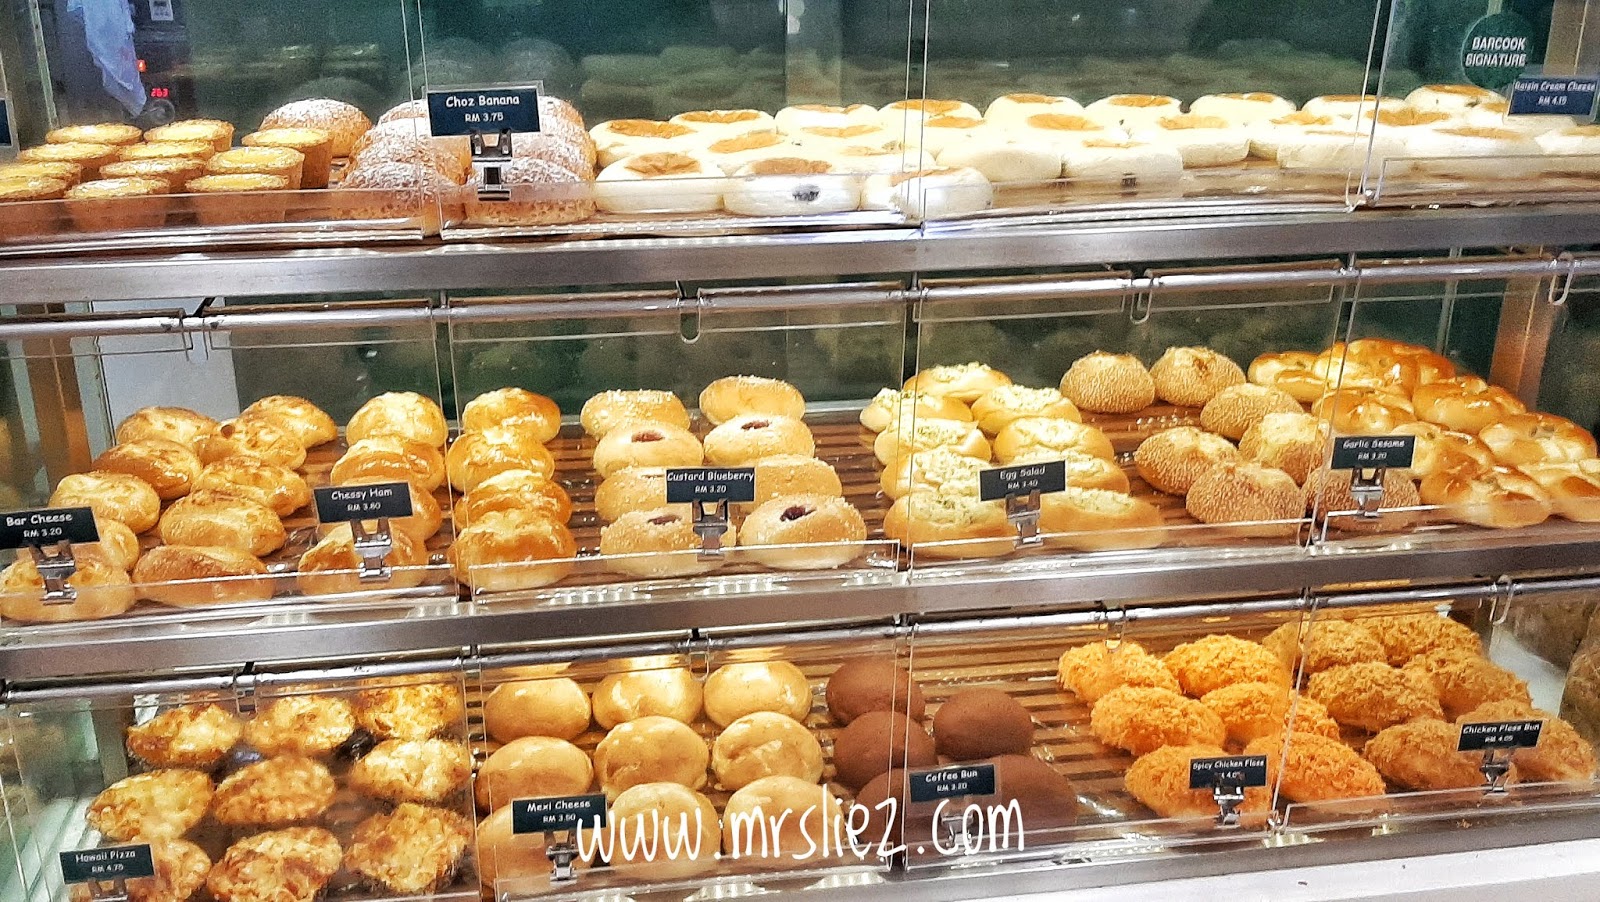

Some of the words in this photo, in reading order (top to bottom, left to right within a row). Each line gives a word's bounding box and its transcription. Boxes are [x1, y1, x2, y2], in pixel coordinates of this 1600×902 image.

[1465, 53, 1528, 68] SIGNATURE
[1540, 81, 1566, 94] Cream
[1567, 81, 1596, 95] Cheese
[445, 95, 475, 107] Choz
[478, 94, 520, 106] Banana
[1537, 96, 1551, 106] RM
[464, 112, 481, 122] RM
[482, 111, 504, 121] 3.75
[1342, 440, 1369, 449] Garlic
[1371, 439, 1405, 449] Sesame
[1357, 452, 1370, 460] RM
[667, 471, 705, 482] Custard
[707, 470, 755, 483] Blueberry
[999, 470, 1017, 482] Egg
[1019, 465, 1046, 479] Salad
[369, 487, 393, 498] Ham
[695, 486, 708, 494] RM
[709, 485, 727, 494] 3.20
[1007, 482, 1020, 490] RM
[347, 503, 361, 512] RM
[6, 516, 27, 527] Bar
[30, 512, 73, 524] Cheese
[23, 527, 41, 539] RM
[41, 525, 63, 537] 3.20
[1462, 725, 1497, 735] Chicken
[1524, 722, 1541, 733] Bun
[1192, 761, 1212, 771] Spicy
[1214, 758, 1244, 769] Chicken
[925, 770, 958, 782] Coffee
[960, 767, 978, 777] Bun
[936, 783, 949, 792] RM
[527, 799, 553, 812] Mexi
[554, 797, 591, 809] Cheese
[542, 814, 557, 823] RM
[75, 852, 108, 863] Hawaii
[109, 848, 136, 860] Pizza
[91, 865, 105, 873] RM
